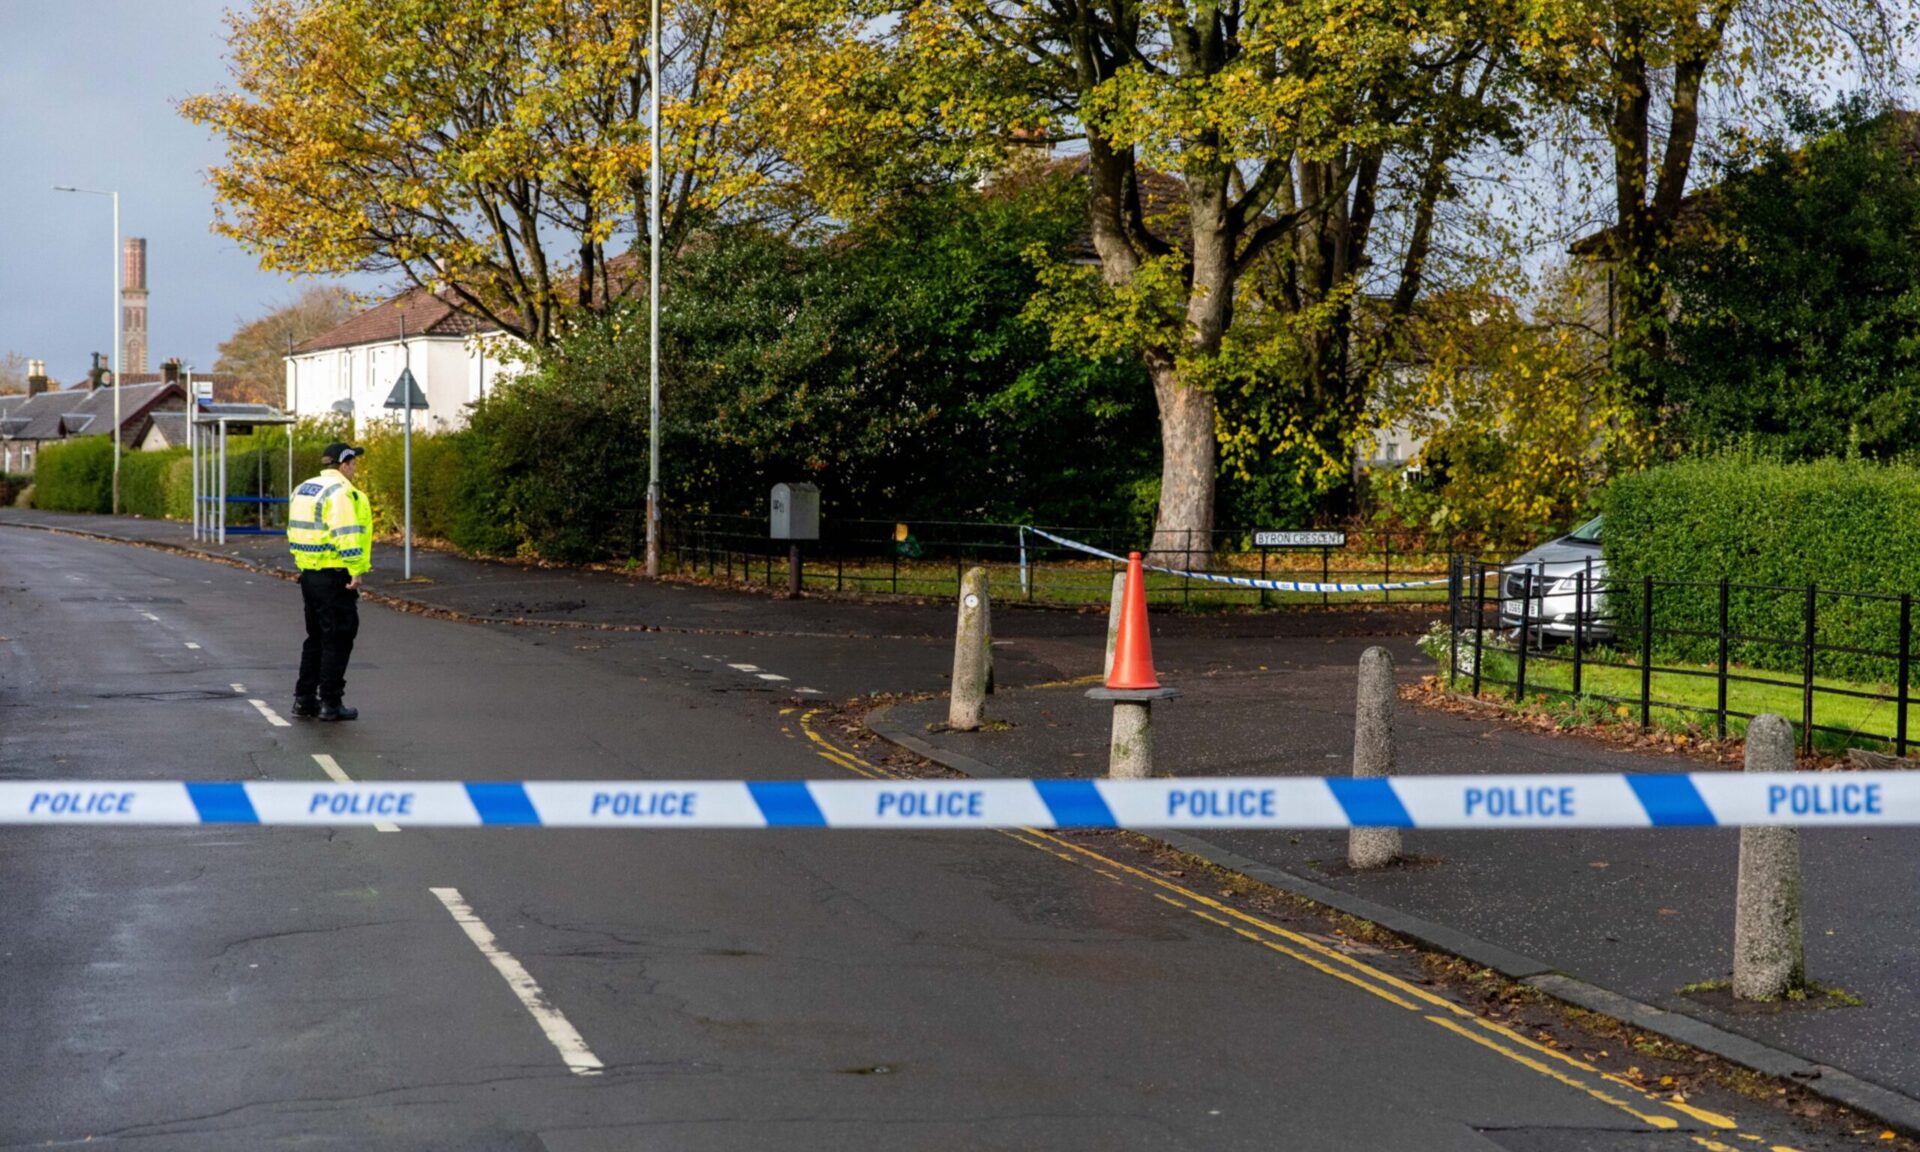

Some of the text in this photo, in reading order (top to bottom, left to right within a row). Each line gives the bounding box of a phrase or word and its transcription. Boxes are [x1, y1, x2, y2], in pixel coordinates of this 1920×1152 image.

[1258, 533, 1290, 544] BYRON
[28, 784, 1883, 818] POLICE POLICE POLICE POLICE POLICE POLICE POLICE
